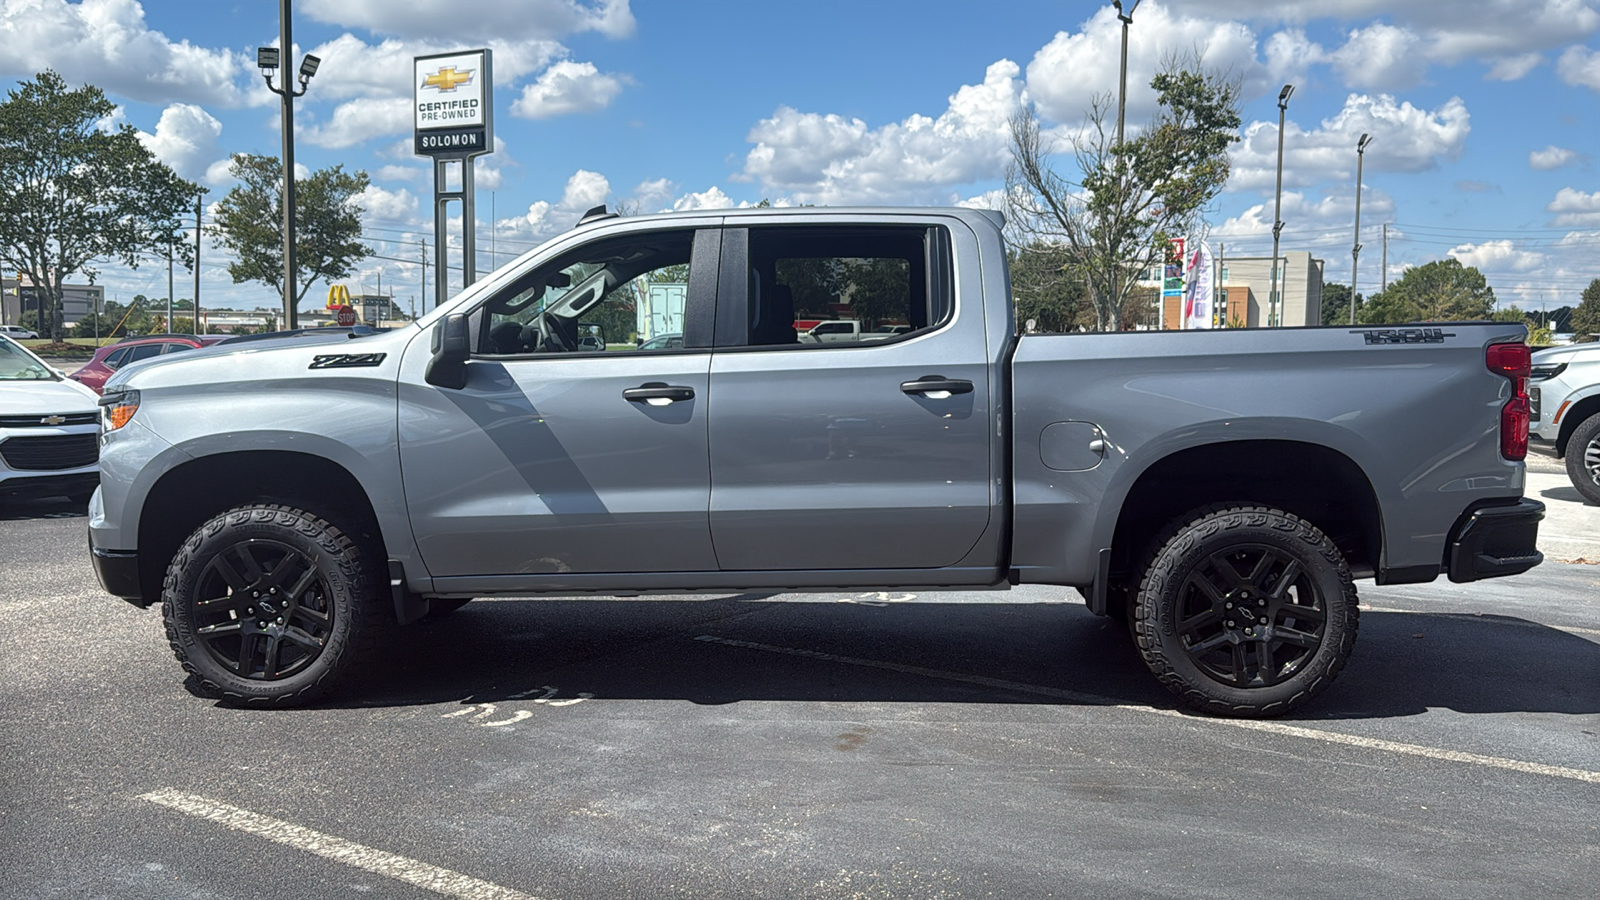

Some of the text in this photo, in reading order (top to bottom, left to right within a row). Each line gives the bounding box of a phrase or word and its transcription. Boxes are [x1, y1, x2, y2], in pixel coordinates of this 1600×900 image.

[418, 98, 479, 112] CERTIFIED
[421, 108, 476, 121] PRE-OWNED
[422, 133, 477, 147] SOLOMON
[338, 312, 355, 323] STOP
